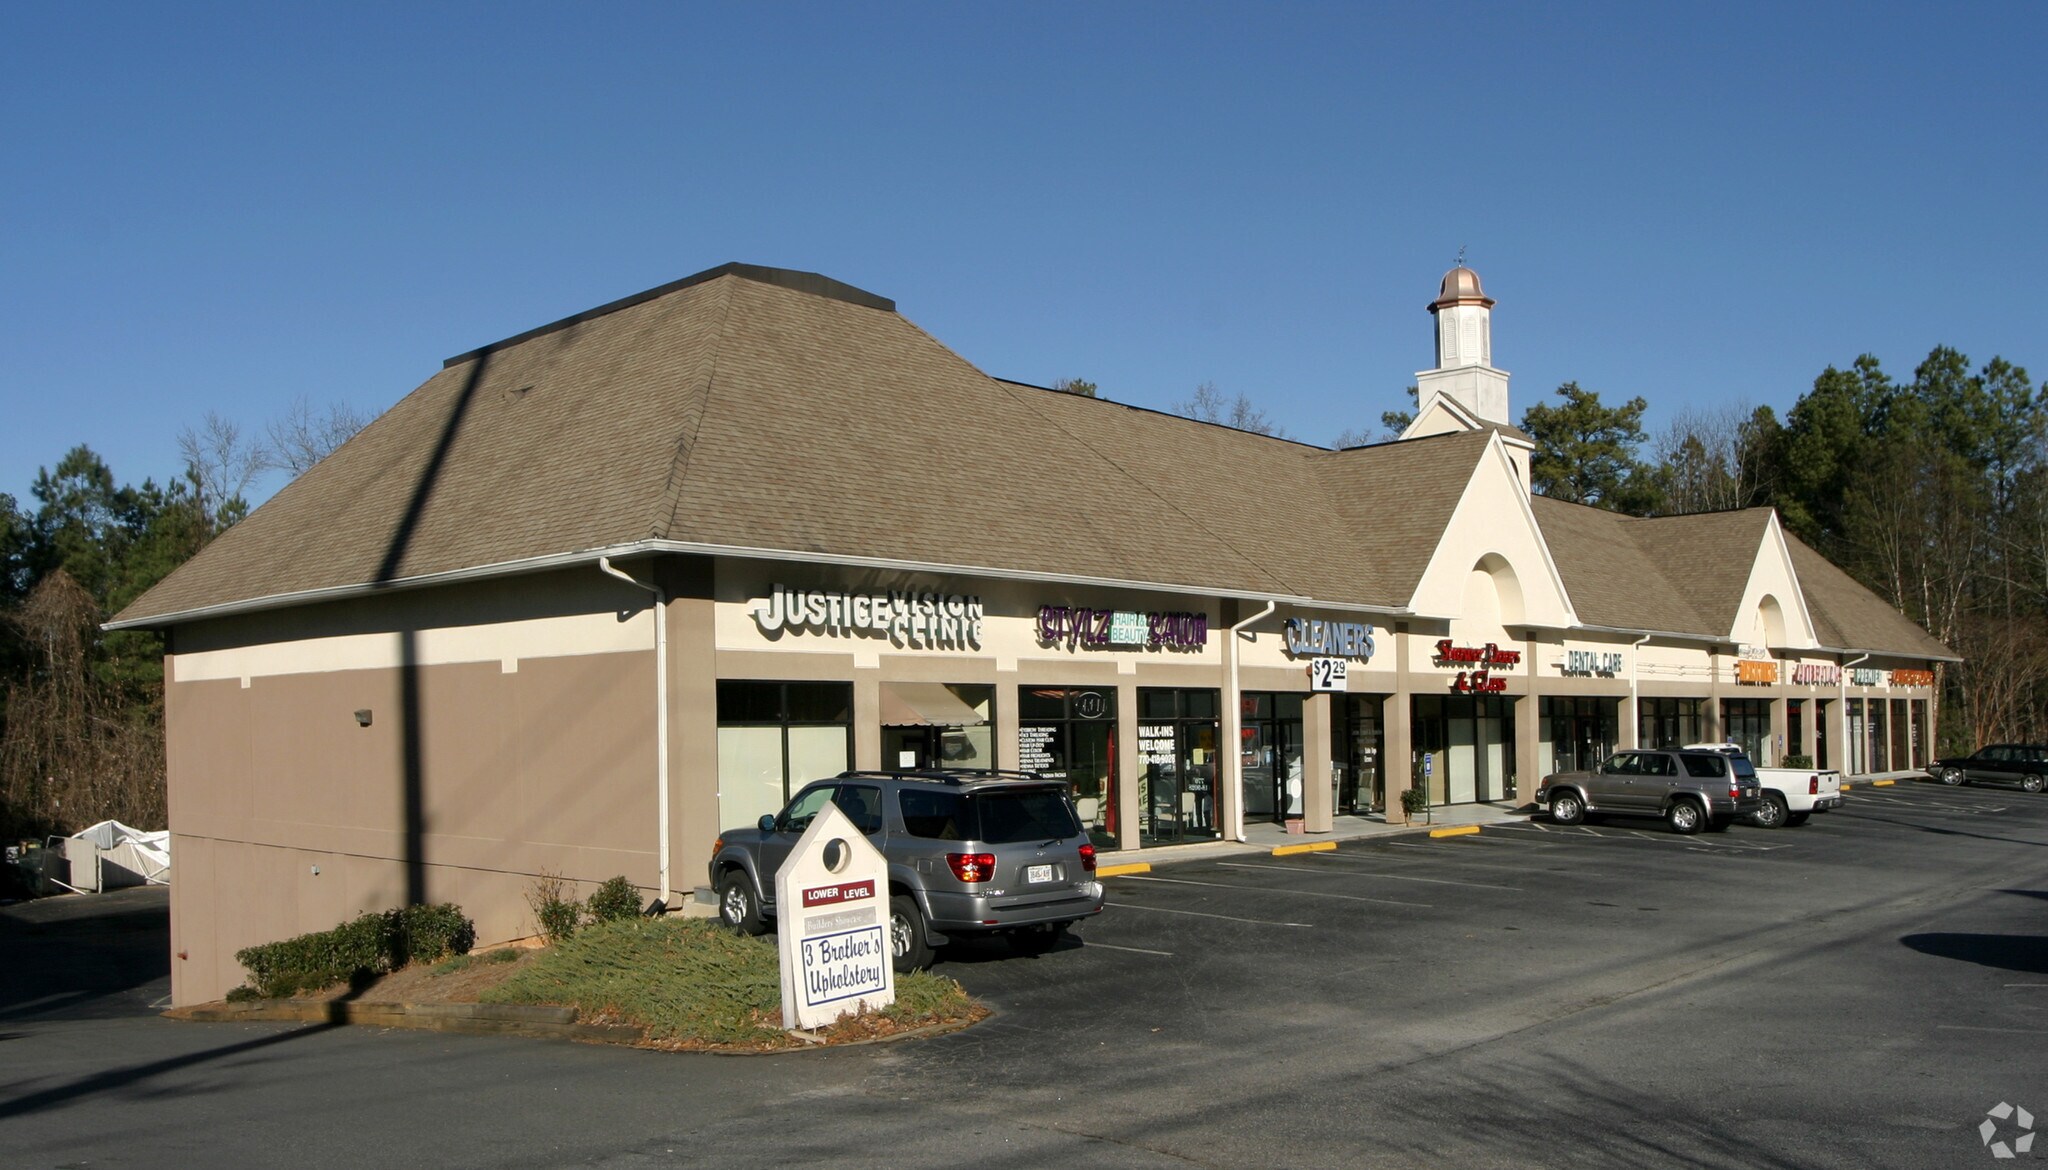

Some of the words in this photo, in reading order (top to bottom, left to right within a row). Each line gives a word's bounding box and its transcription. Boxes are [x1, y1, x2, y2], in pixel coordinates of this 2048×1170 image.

[755, 583, 888, 630] JUSTICE
[890, 589, 983, 619] VISION
[890, 615, 983, 642] CLINIC
[1038, 604, 1112, 645] STYLZ
[1114, 612, 1136, 626] HAIR
[1137, 613, 1147, 626] &
[1148, 612, 1207, 646] SALON
[1112, 628, 1148, 642] BEAUTY
[1287, 617, 1375, 657] CLEANERS
[1568, 650, 1600, 671] DENTAL
[1603, 652, 1622, 673] CARE
[1138, 726, 1174, 738] WALK-INS
[1138, 739, 1176, 751] WELCOME
[807, 887, 839, 900] LOWER
[843, 887, 870, 899] LEVEL
[805, 943, 814, 967] 3
[818, 932, 880, 965] Brother's
[810, 963, 880, 998] Upholstery
